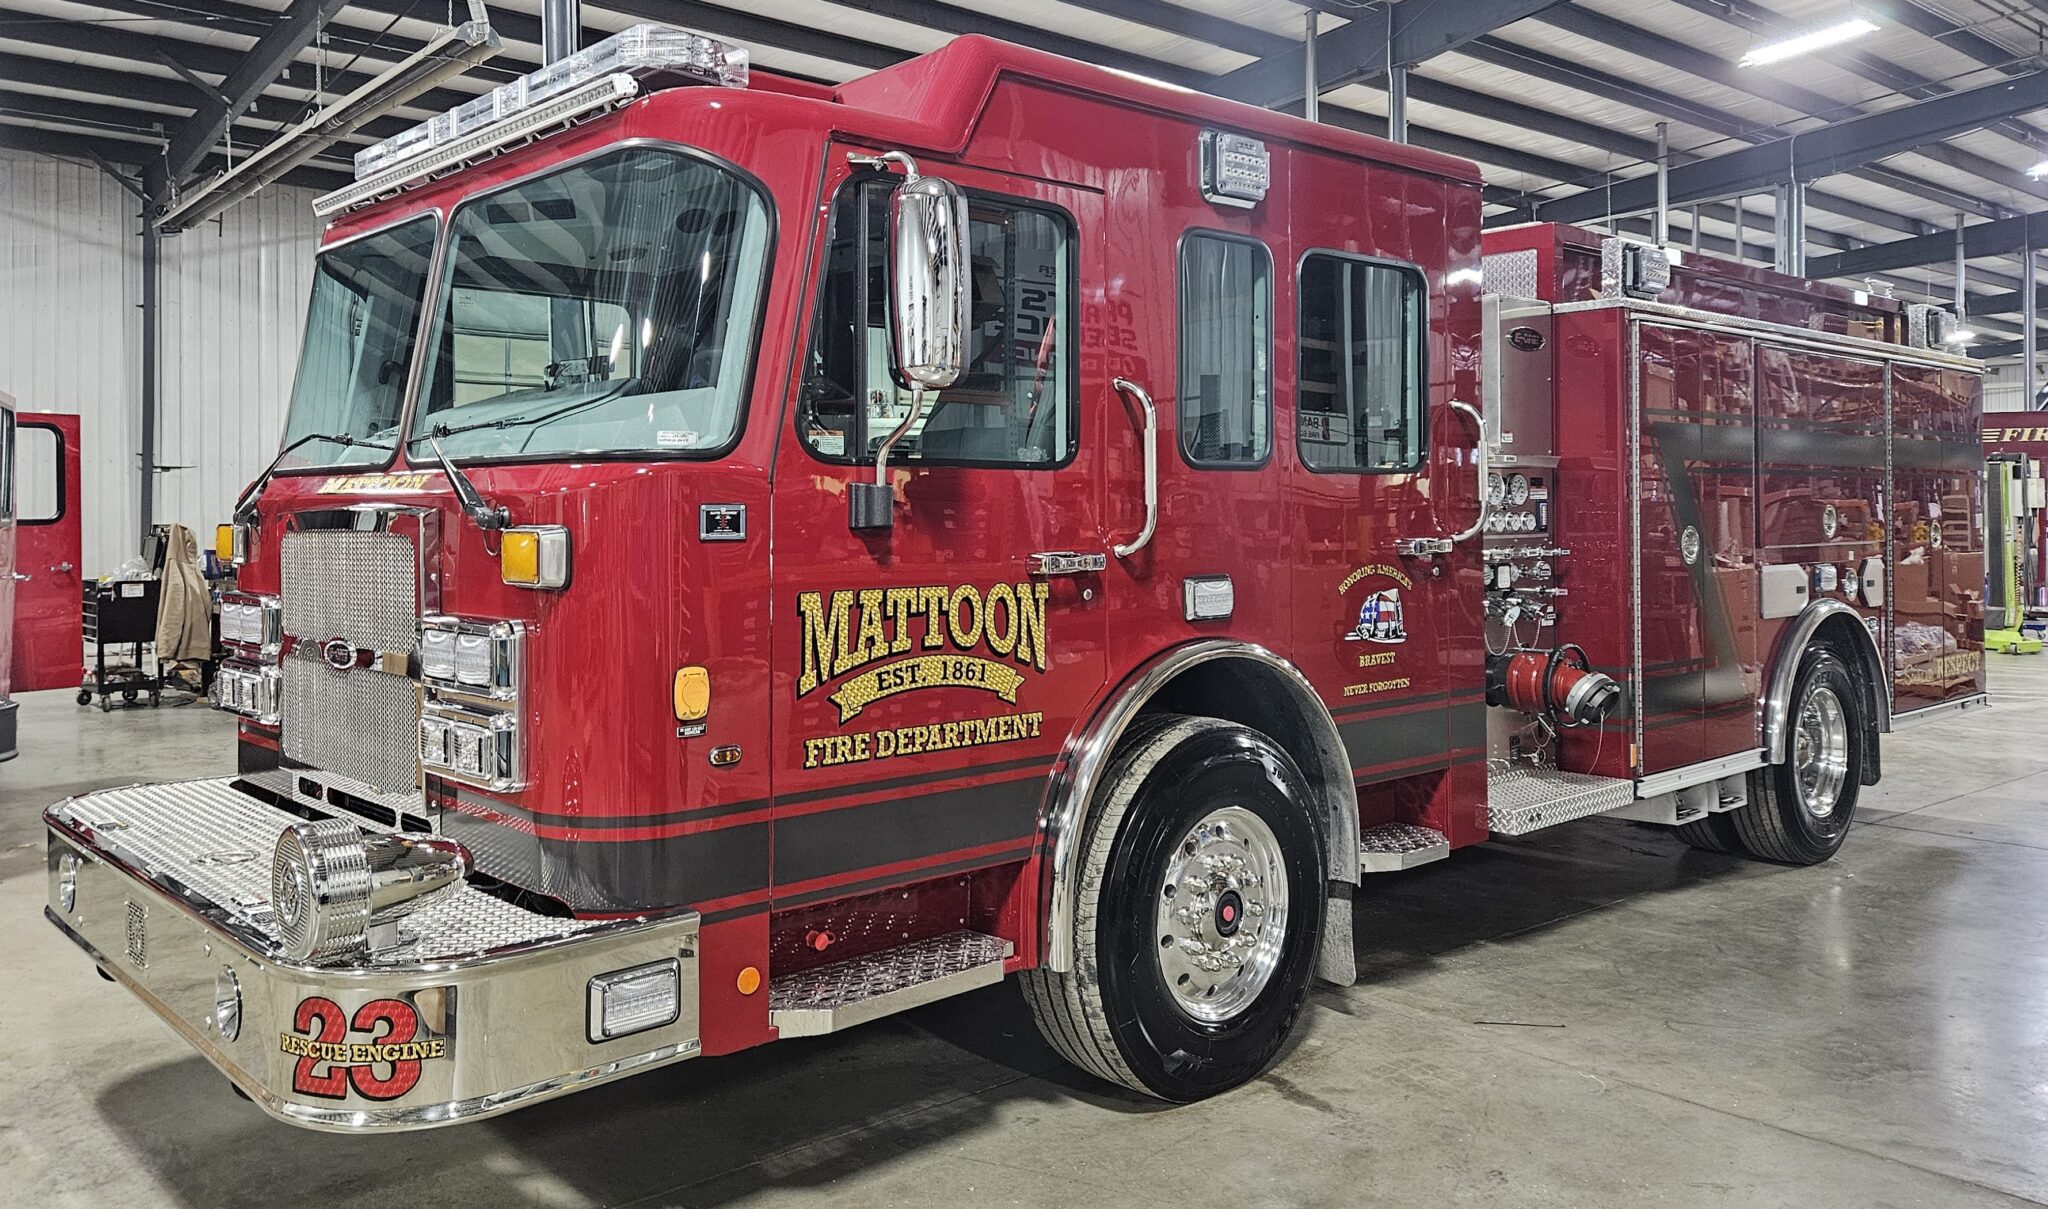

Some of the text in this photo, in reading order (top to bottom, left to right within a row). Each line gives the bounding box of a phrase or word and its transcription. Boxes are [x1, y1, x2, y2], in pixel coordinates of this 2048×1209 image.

[796, 582, 1049, 701] MATTOON
[1358, 651, 1396, 668] BRAVEST
[876, 661, 987, 691] EST. 1861
[1343, 677, 1411, 697] NEVER FORGOTTEN
[804, 711, 1043, 770] FIRE DEPARTMENT
[280, 1032, 445, 1064] RESCUE ENGINE
[293, 996, 422, 1102] 23
